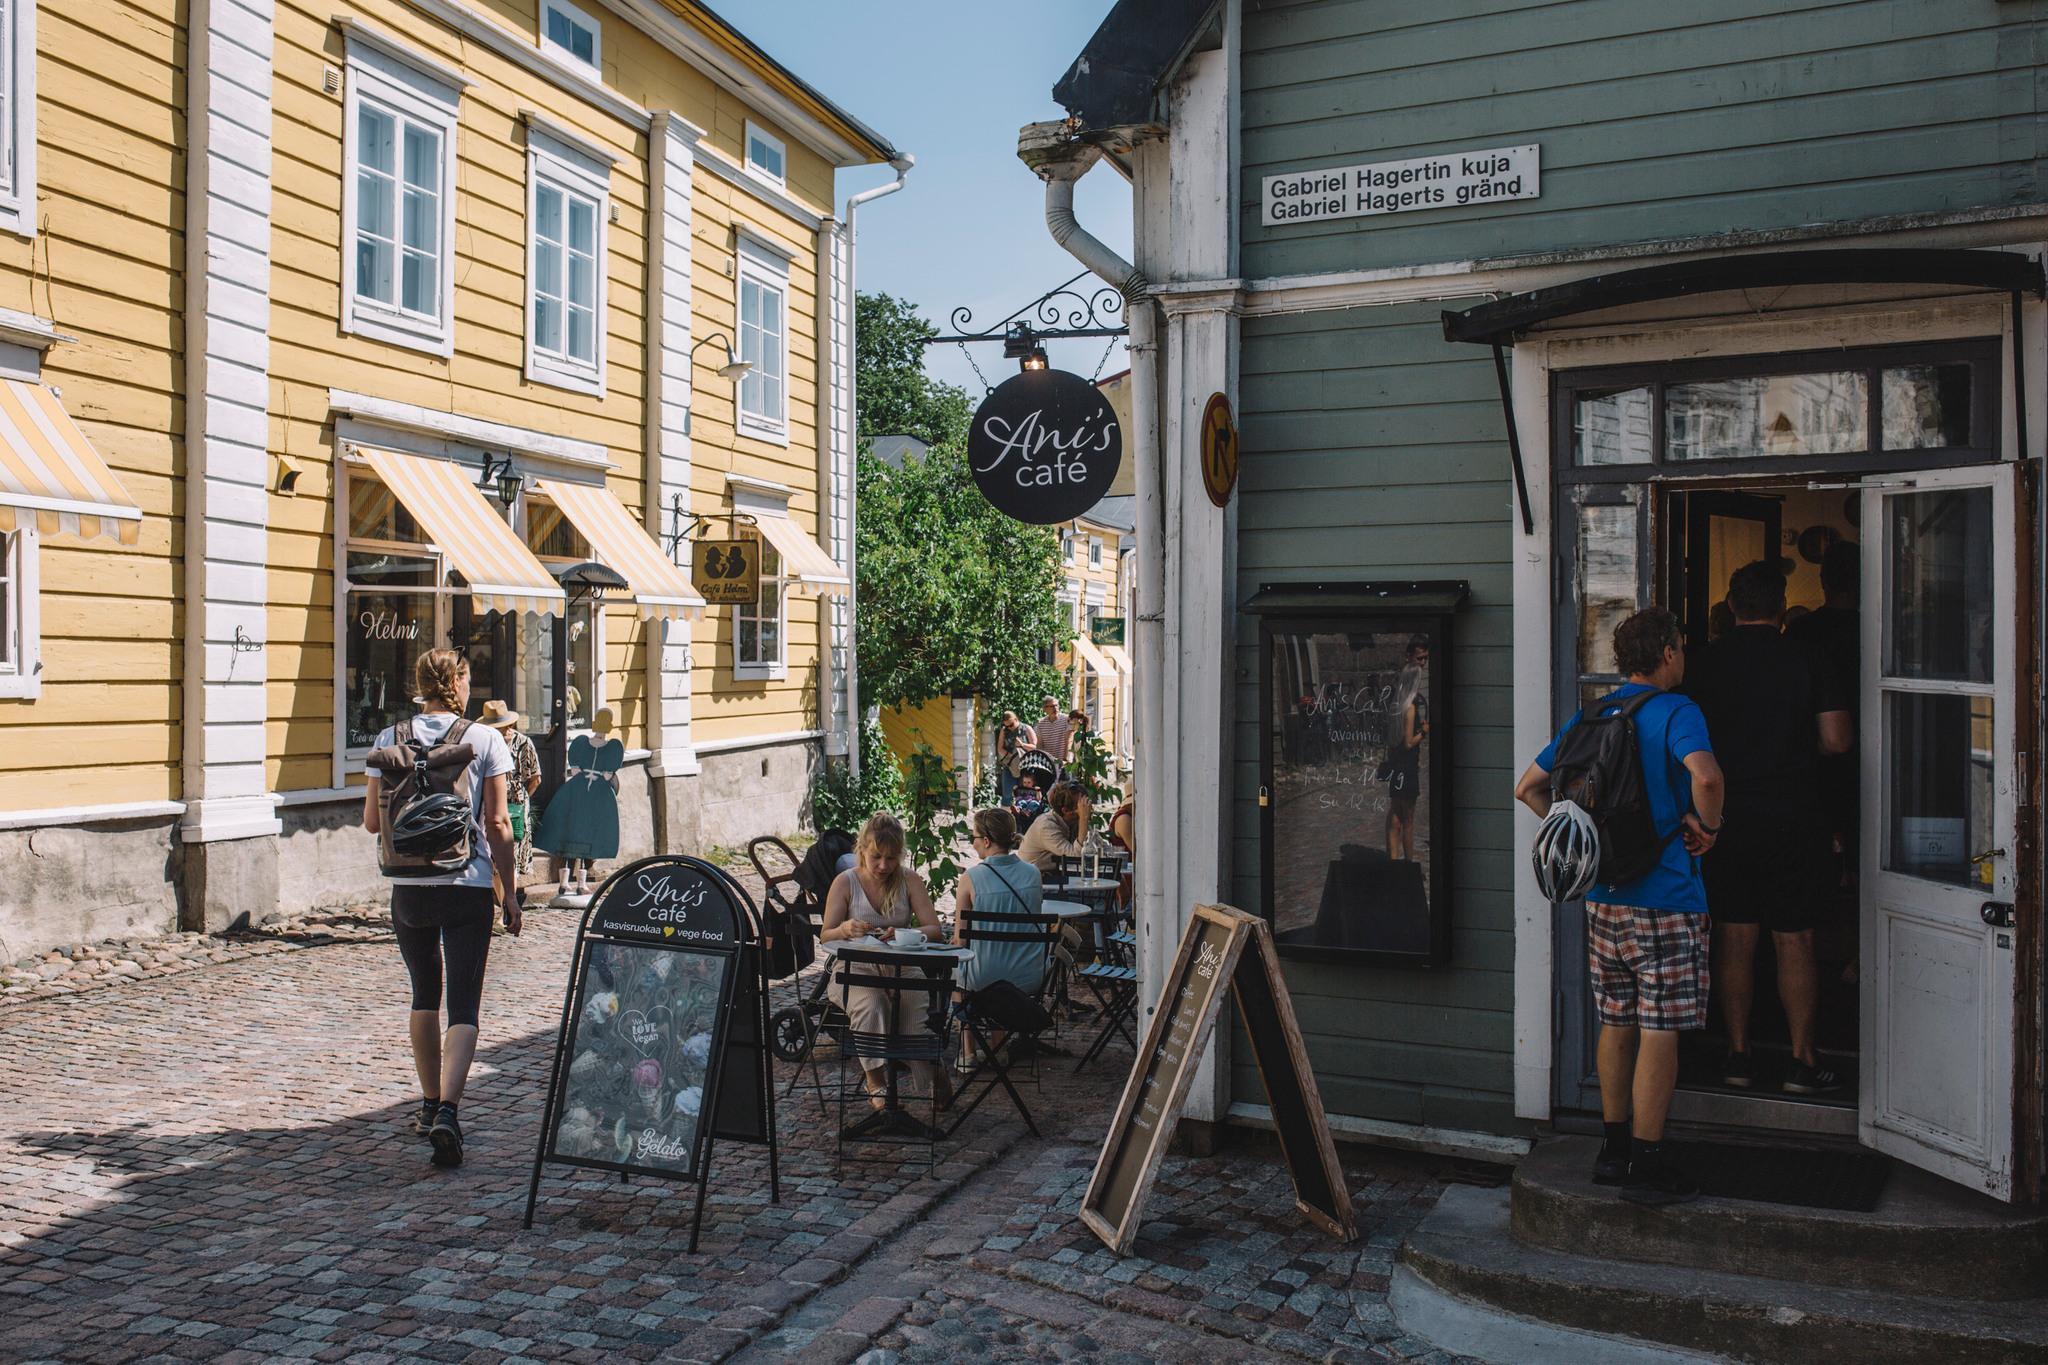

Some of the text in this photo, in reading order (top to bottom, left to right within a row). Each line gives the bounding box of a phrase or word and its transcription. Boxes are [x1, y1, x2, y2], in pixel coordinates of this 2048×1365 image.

[1270, 154, 1511, 200] Gabriel Hagertin kuja
[1270, 175, 1521, 220] Gabriel Hagerts gränd
[976, 407, 1117, 473] Ani's
[1015, 452, 1088, 487] café
[360, 611, 419, 640] Helmi
[627, 874, 708, 907] Ani's
[648, 904, 687, 923] café
[603, 919, 724, 941] kasvisruokaa vege food
[1197, 964, 1214, 979] café
[632, 1022, 657, 1035] LOVE
[636, 1135, 687, 1160] Gelato
